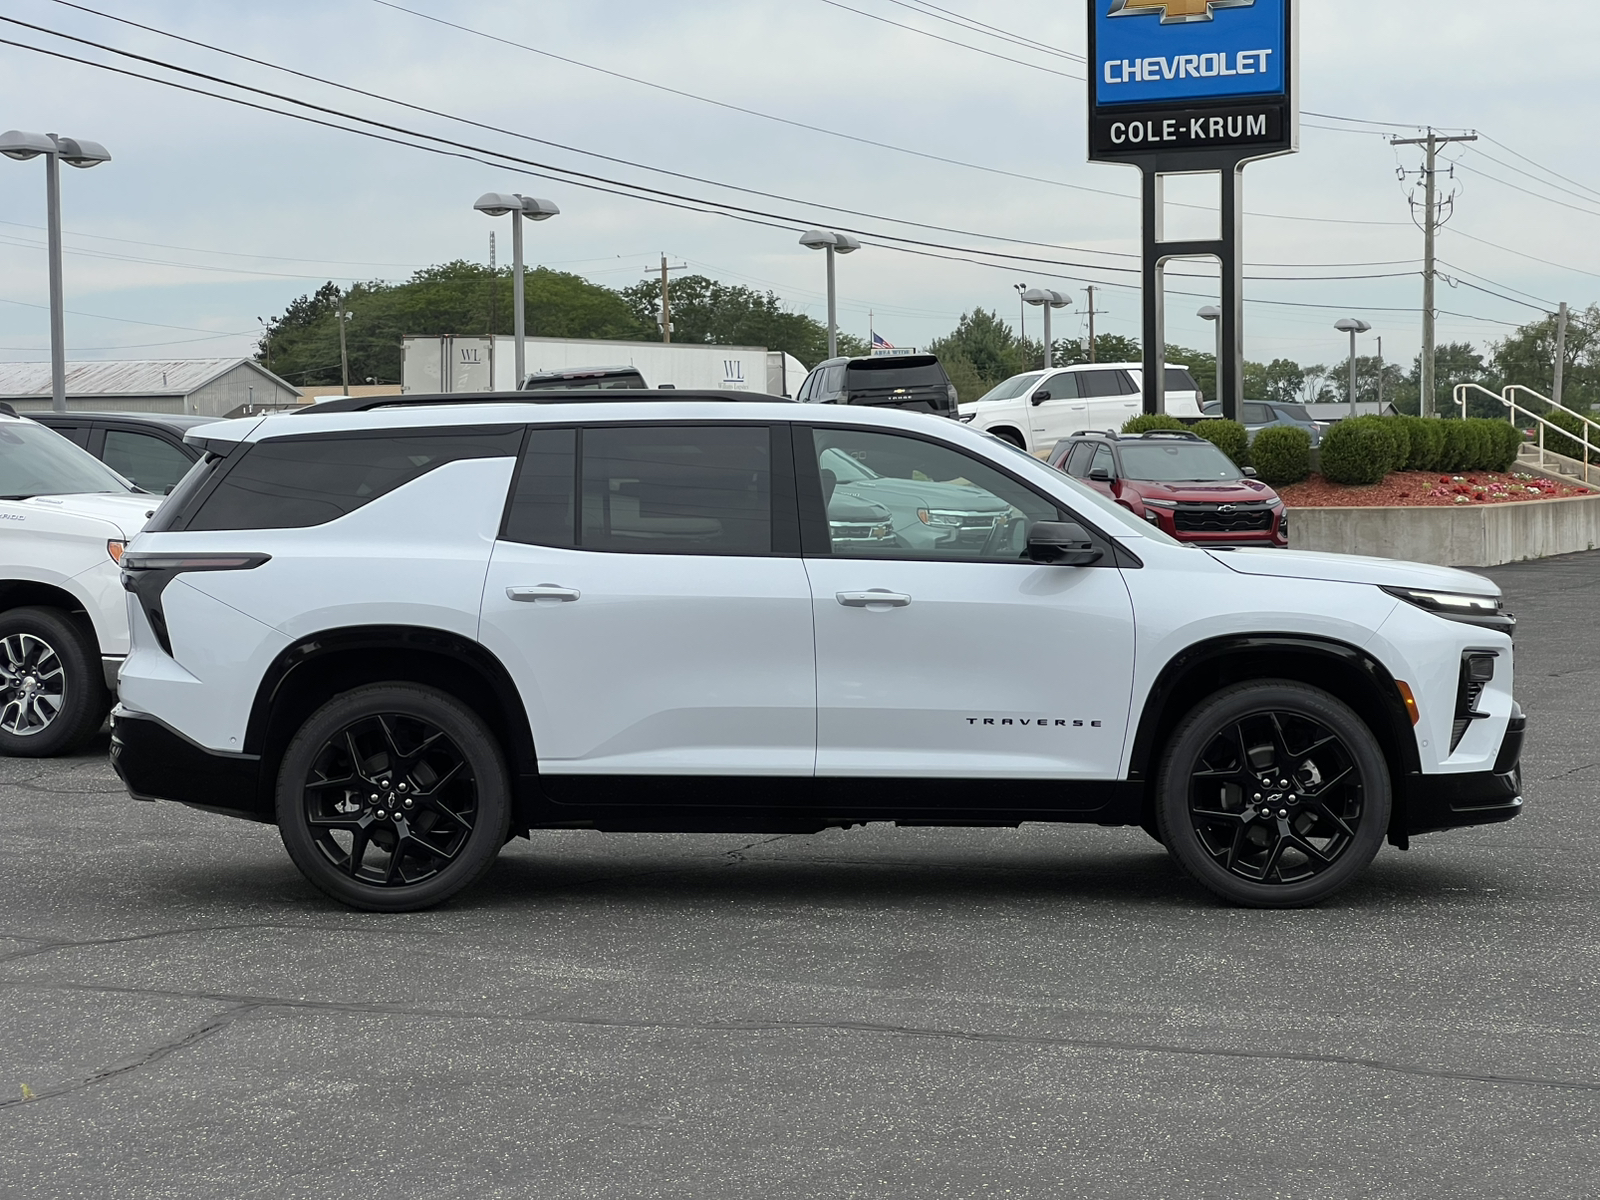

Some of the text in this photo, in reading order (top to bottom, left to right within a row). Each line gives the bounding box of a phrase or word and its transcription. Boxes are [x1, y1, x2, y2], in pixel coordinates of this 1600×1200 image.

[1104, 49, 1272, 84] CHEVROLET
[1110, 114, 1266, 144] COLE-KRUM
[461, 349, 481, 361] WL
[723, 360, 744, 379] WL
[966, 718, 1102, 728] TRAVERSE
